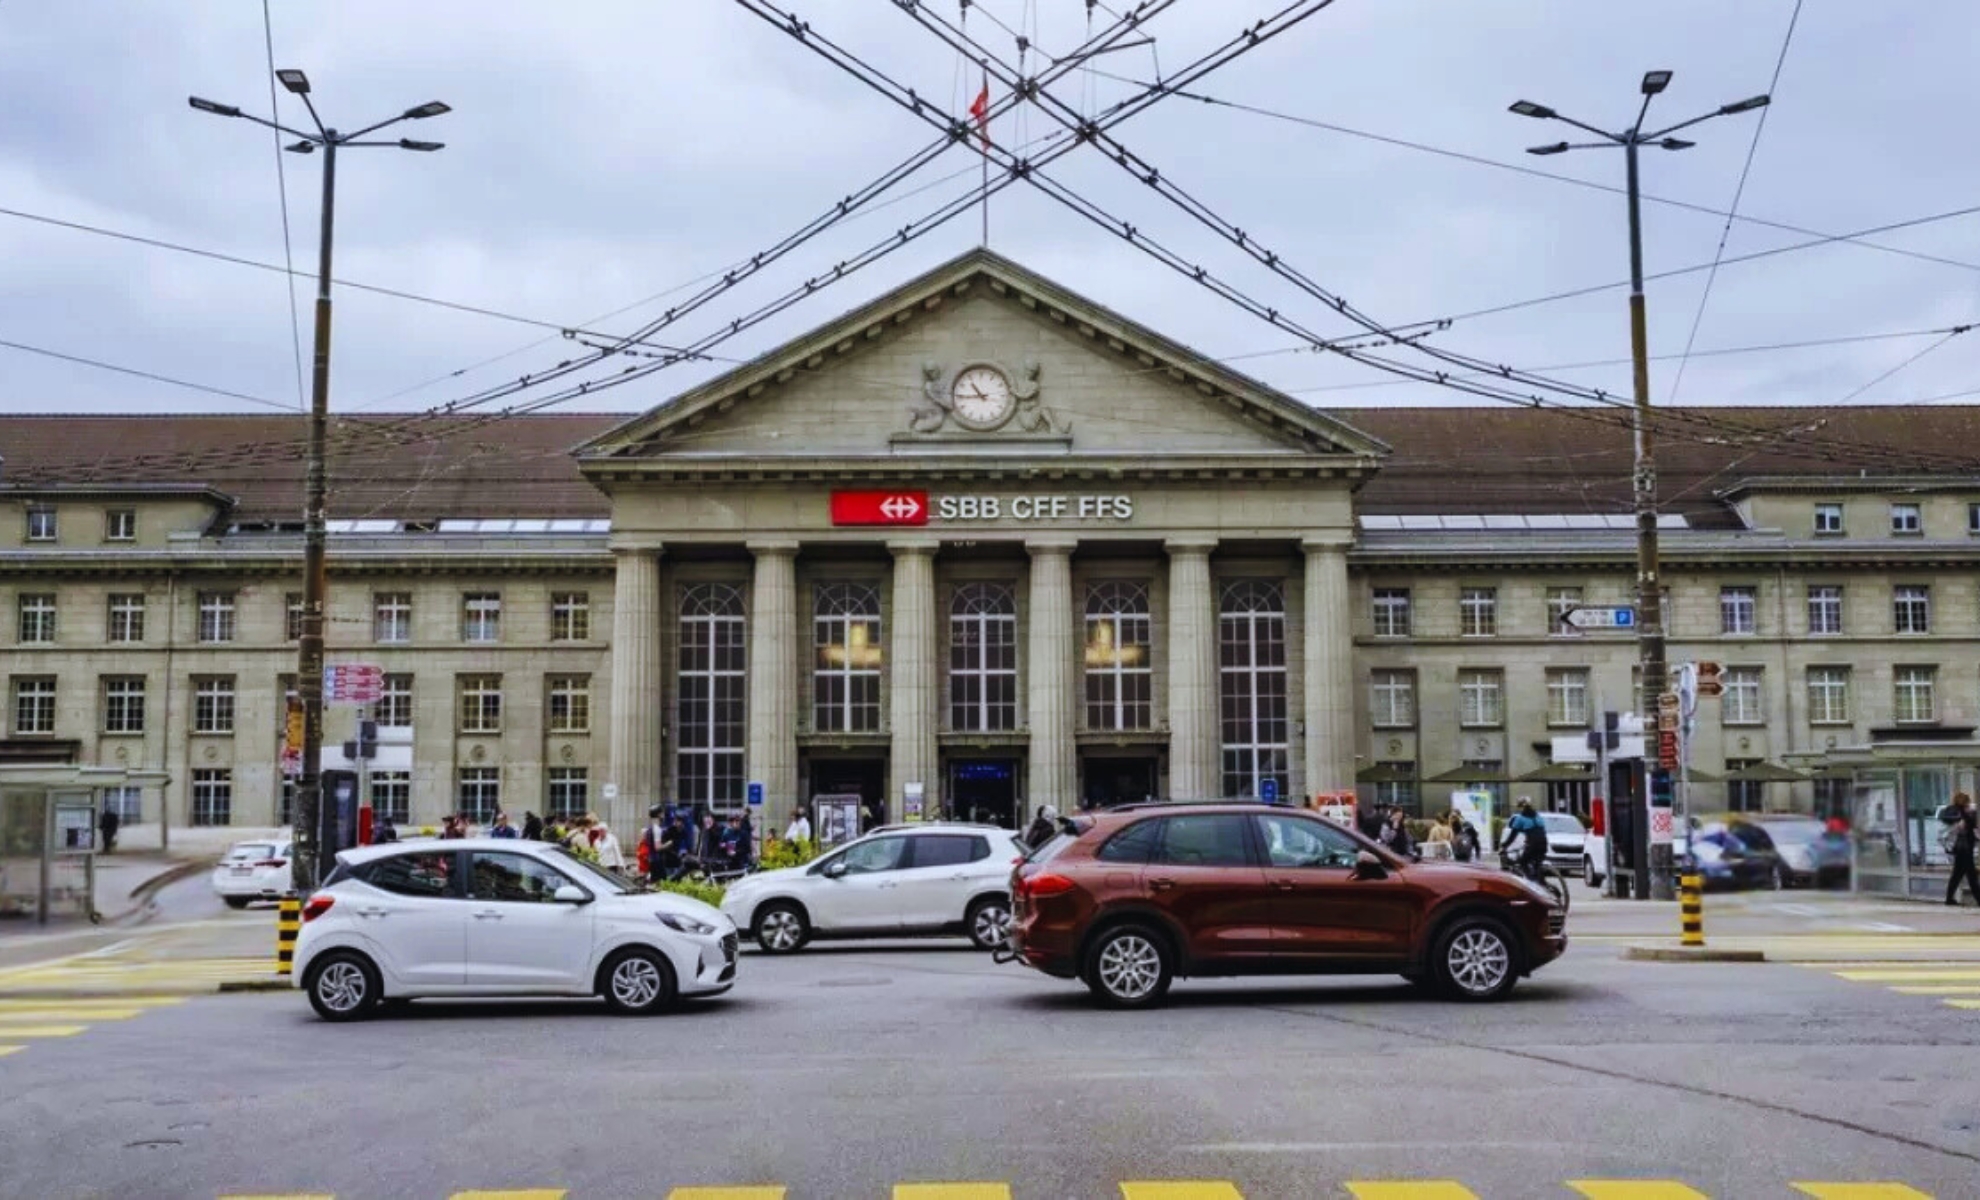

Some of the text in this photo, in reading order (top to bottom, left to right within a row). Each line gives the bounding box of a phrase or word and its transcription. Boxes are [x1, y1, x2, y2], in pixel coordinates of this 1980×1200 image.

[939, 496, 1133, 518] SBB CFF FFS
